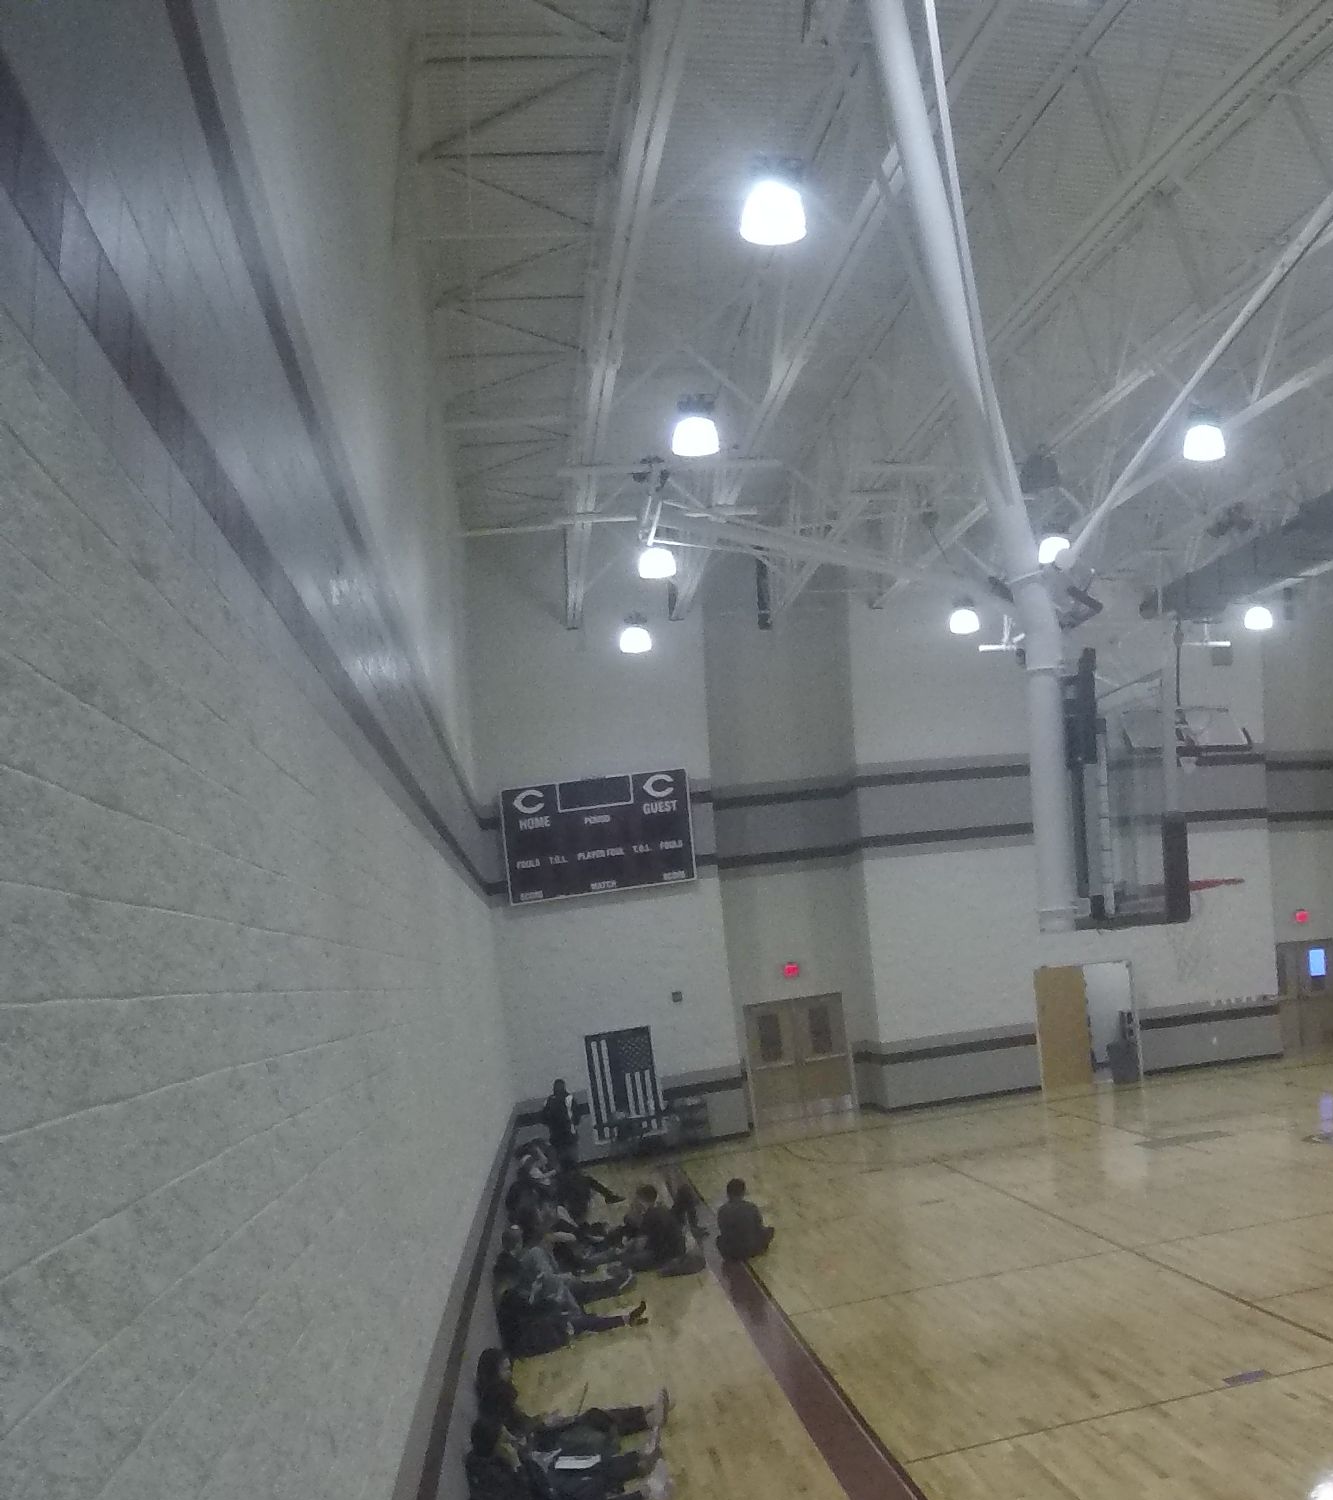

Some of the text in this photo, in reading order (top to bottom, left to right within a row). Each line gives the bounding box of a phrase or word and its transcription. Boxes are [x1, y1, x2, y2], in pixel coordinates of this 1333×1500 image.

[643, 774, 674, 798] C
[513, 789, 545, 814] C
[643, 800, 677, 815] GUEST
[519, 815, 551, 831] HOME
